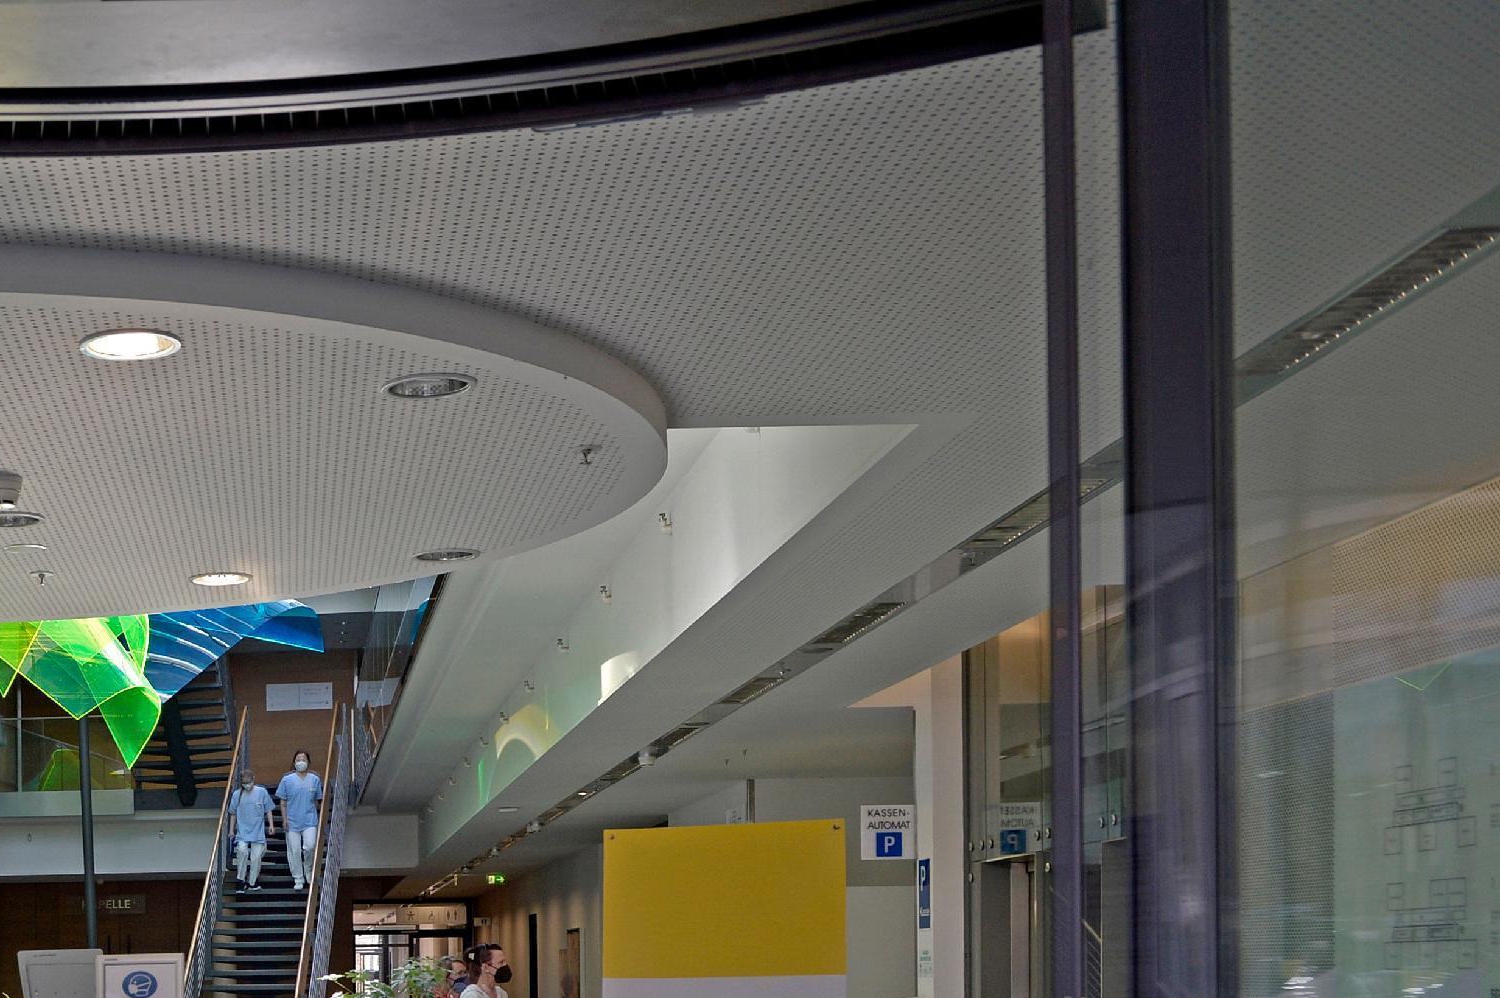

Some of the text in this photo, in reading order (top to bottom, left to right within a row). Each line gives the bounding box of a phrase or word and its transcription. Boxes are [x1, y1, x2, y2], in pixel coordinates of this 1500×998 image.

[867, 808, 910, 818] KASSEN-
[867, 820, 910, 830] AUTOMAT
[884, 836, 896, 854] P
